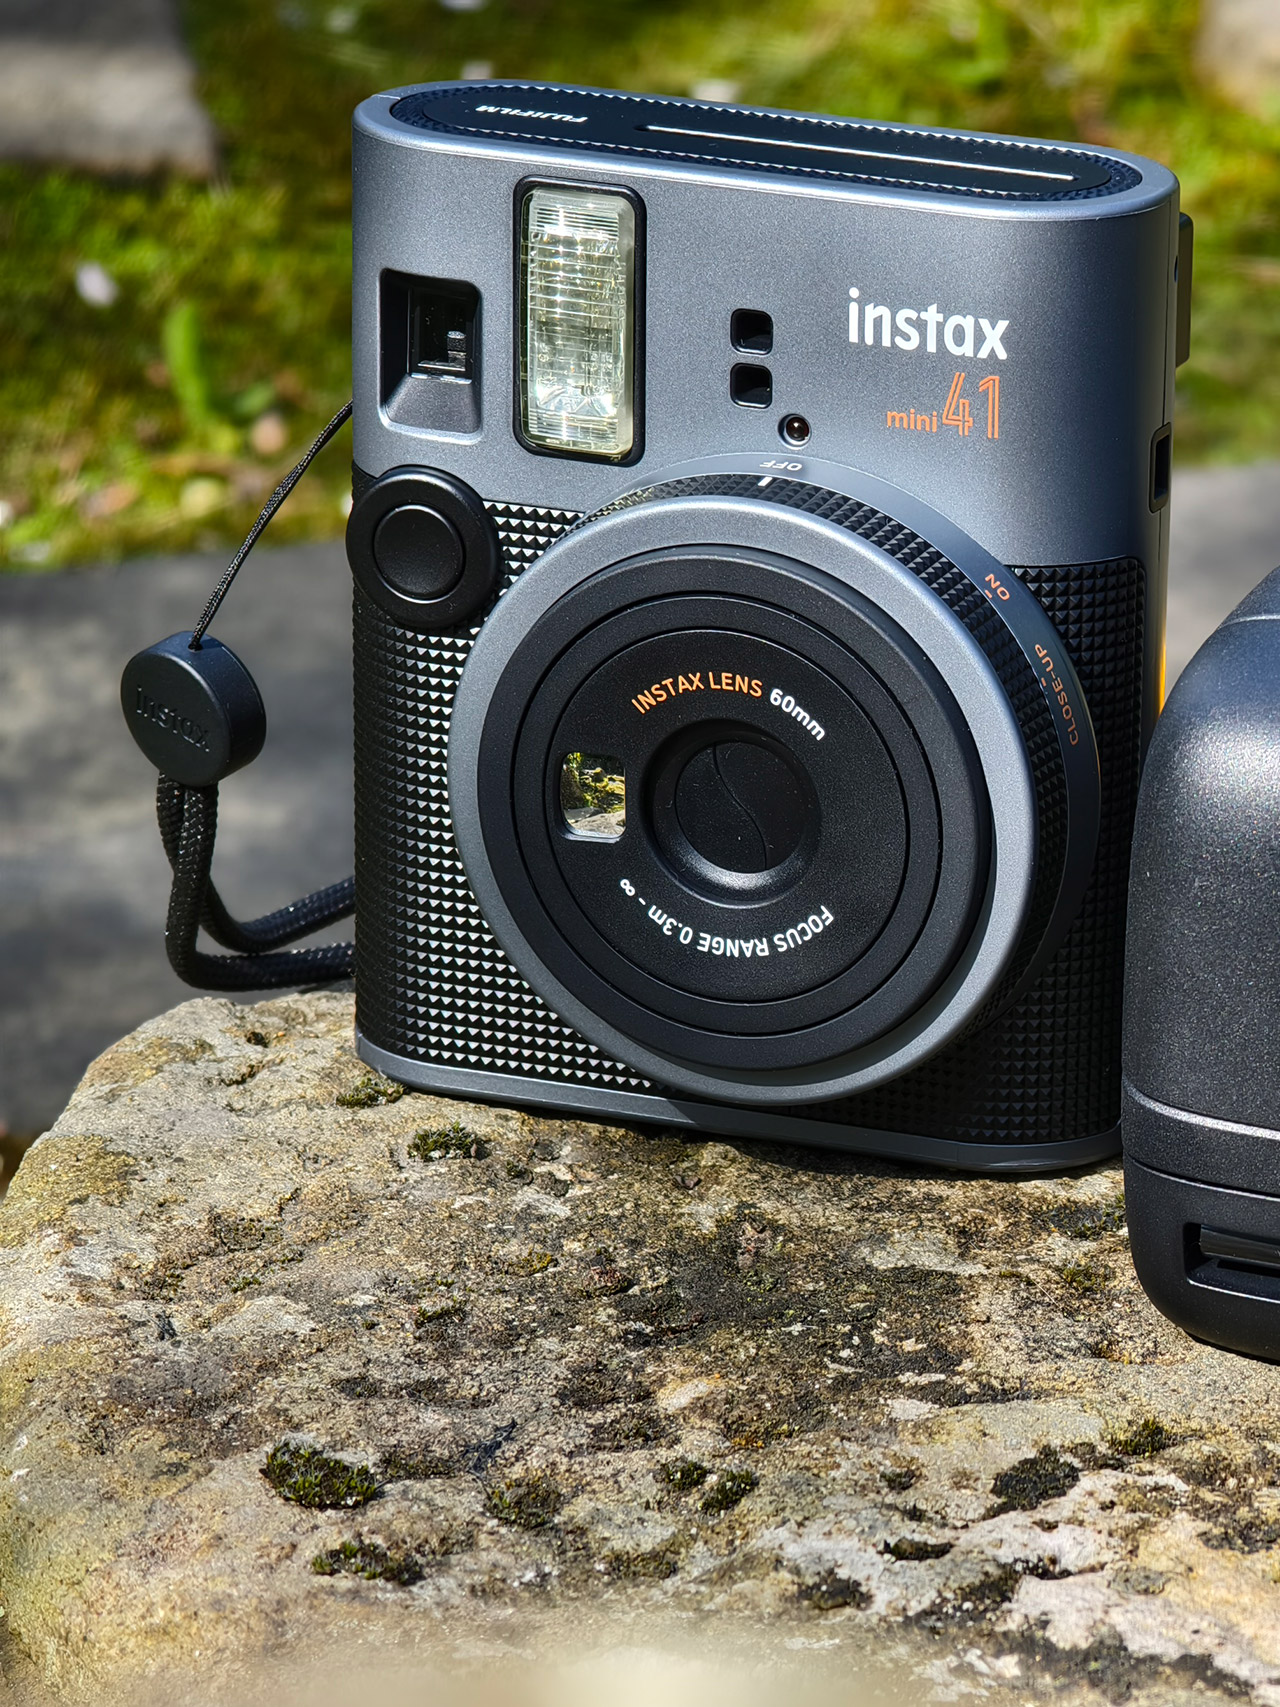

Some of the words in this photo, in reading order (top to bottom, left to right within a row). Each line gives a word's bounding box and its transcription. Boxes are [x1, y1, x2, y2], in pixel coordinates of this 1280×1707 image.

[474, 105, 589, 123] FUJIFILM
[848, 286, 1010, 361] instax
[886, 408, 938, 433] mini
[942, 371, 1000, 440] 41
[759, 460, 803, 471] OFF
[984, 573, 1011, 601] ON
[631, 671, 705, 714] INSTAX
[708, 671, 763, 698] LENS
[769, 687, 826, 741] 60mm
[1034, 643, 1079, 746] CLOSE-UP
[136, 685, 211, 753] instax
[647, 904, 694, 945] 0.3m
[696, 931, 770, 958] RANGE
[773, 905, 835, 953] FOCUS
